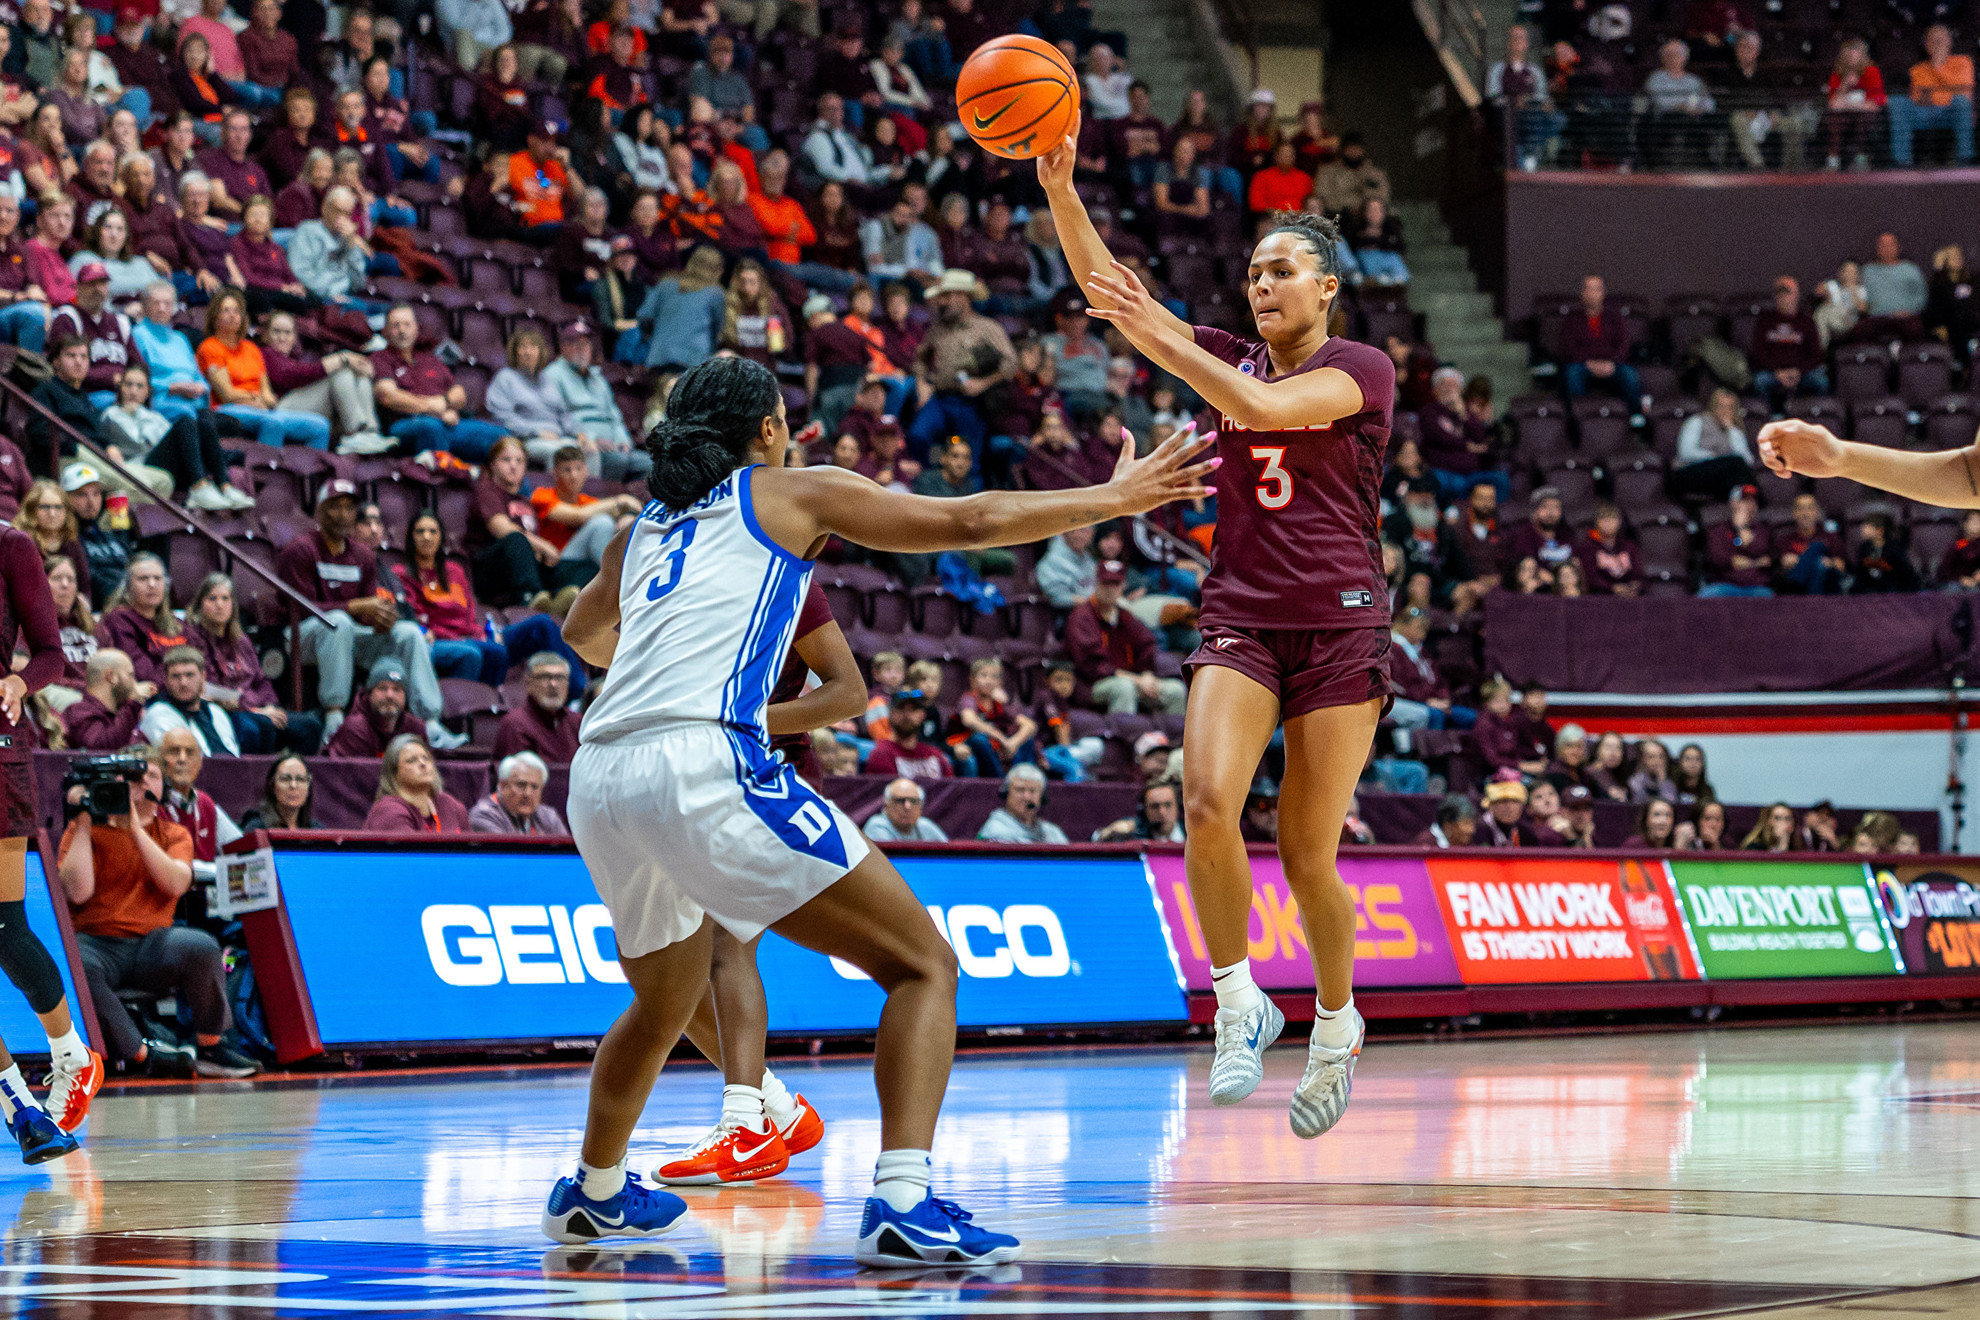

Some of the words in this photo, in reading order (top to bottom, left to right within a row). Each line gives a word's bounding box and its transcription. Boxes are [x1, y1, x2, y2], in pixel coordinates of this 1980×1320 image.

[1250, 446, 1294, 510] 3
[646, 517, 698, 601] 3
[1216, 637, 1240, 649] VT
[787, 800, 831, 847] D
[1446, 881, 1520, 927] FAN
[1512, 882, 1623, 927] WORK
[1685, 885, 1840, 927] DAVENPORT
[421, 904, 629, 986] GEIC
[1461, 931, 1488, 960] IS
[1482, 931, 1567, 960] THIRSTY
[1565, 931, 1634, 959] WORK
